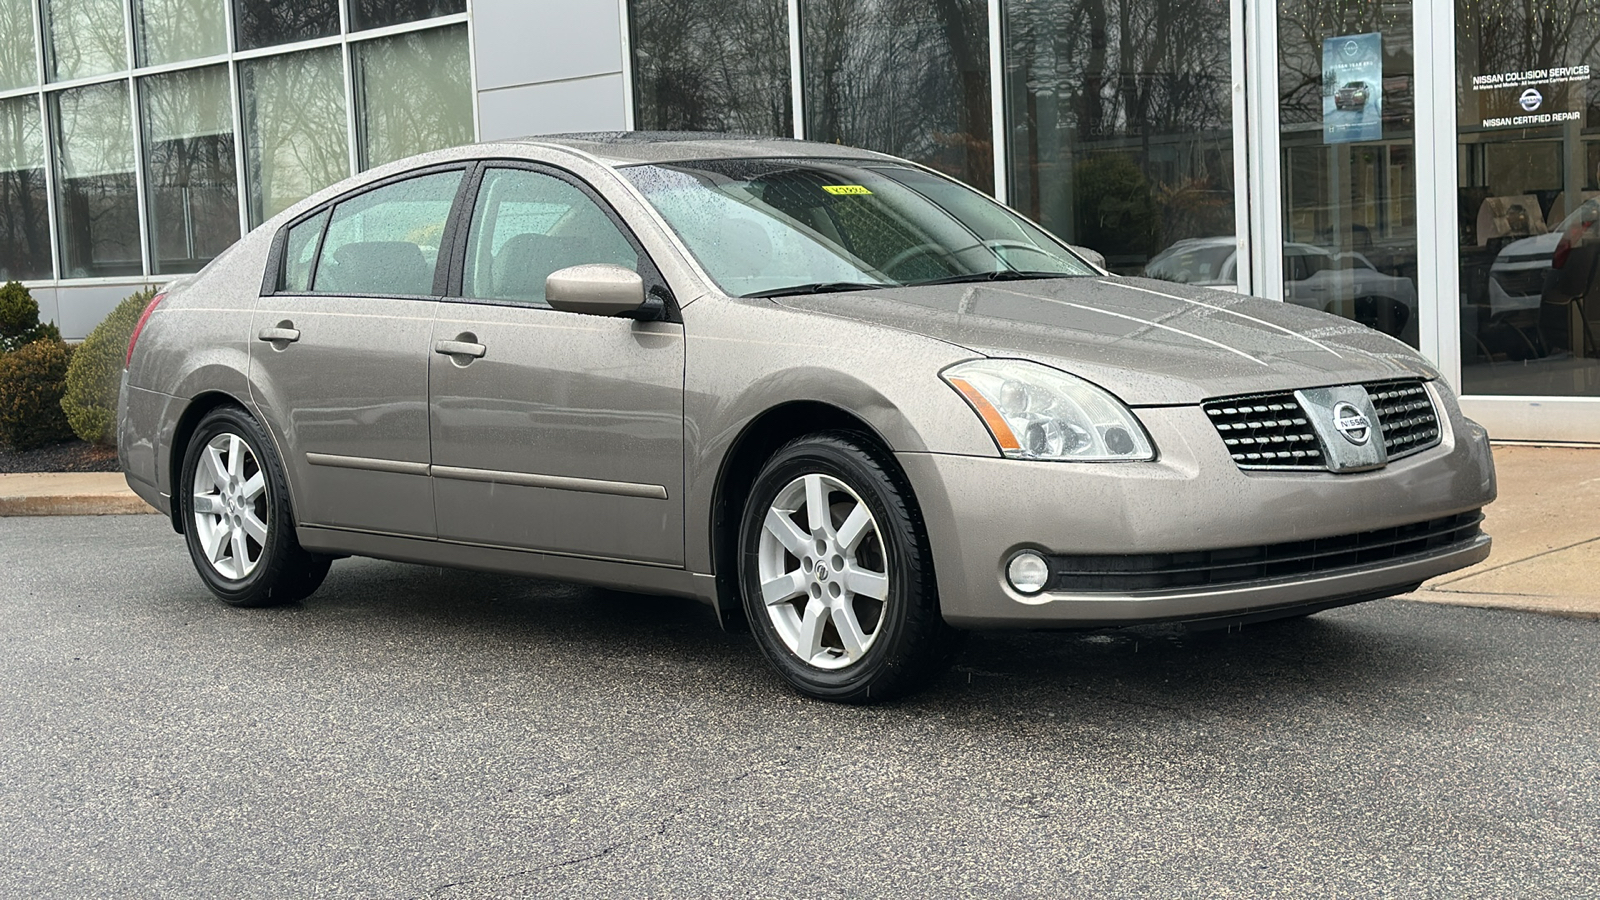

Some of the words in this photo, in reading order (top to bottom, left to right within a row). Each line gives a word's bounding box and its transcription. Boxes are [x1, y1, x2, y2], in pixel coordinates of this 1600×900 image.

[1473, 74, 1503, 84] NISSAN
[1506, 69, 1548, 82] COLLISION
[1549, 65, 1590, 78] SERVICES
[1482, 118, 1512, 128] NISSAN
[1513, 115, 1550, 124] CERTIFIED
[1552, 112, 1580, 121] REPAIR
